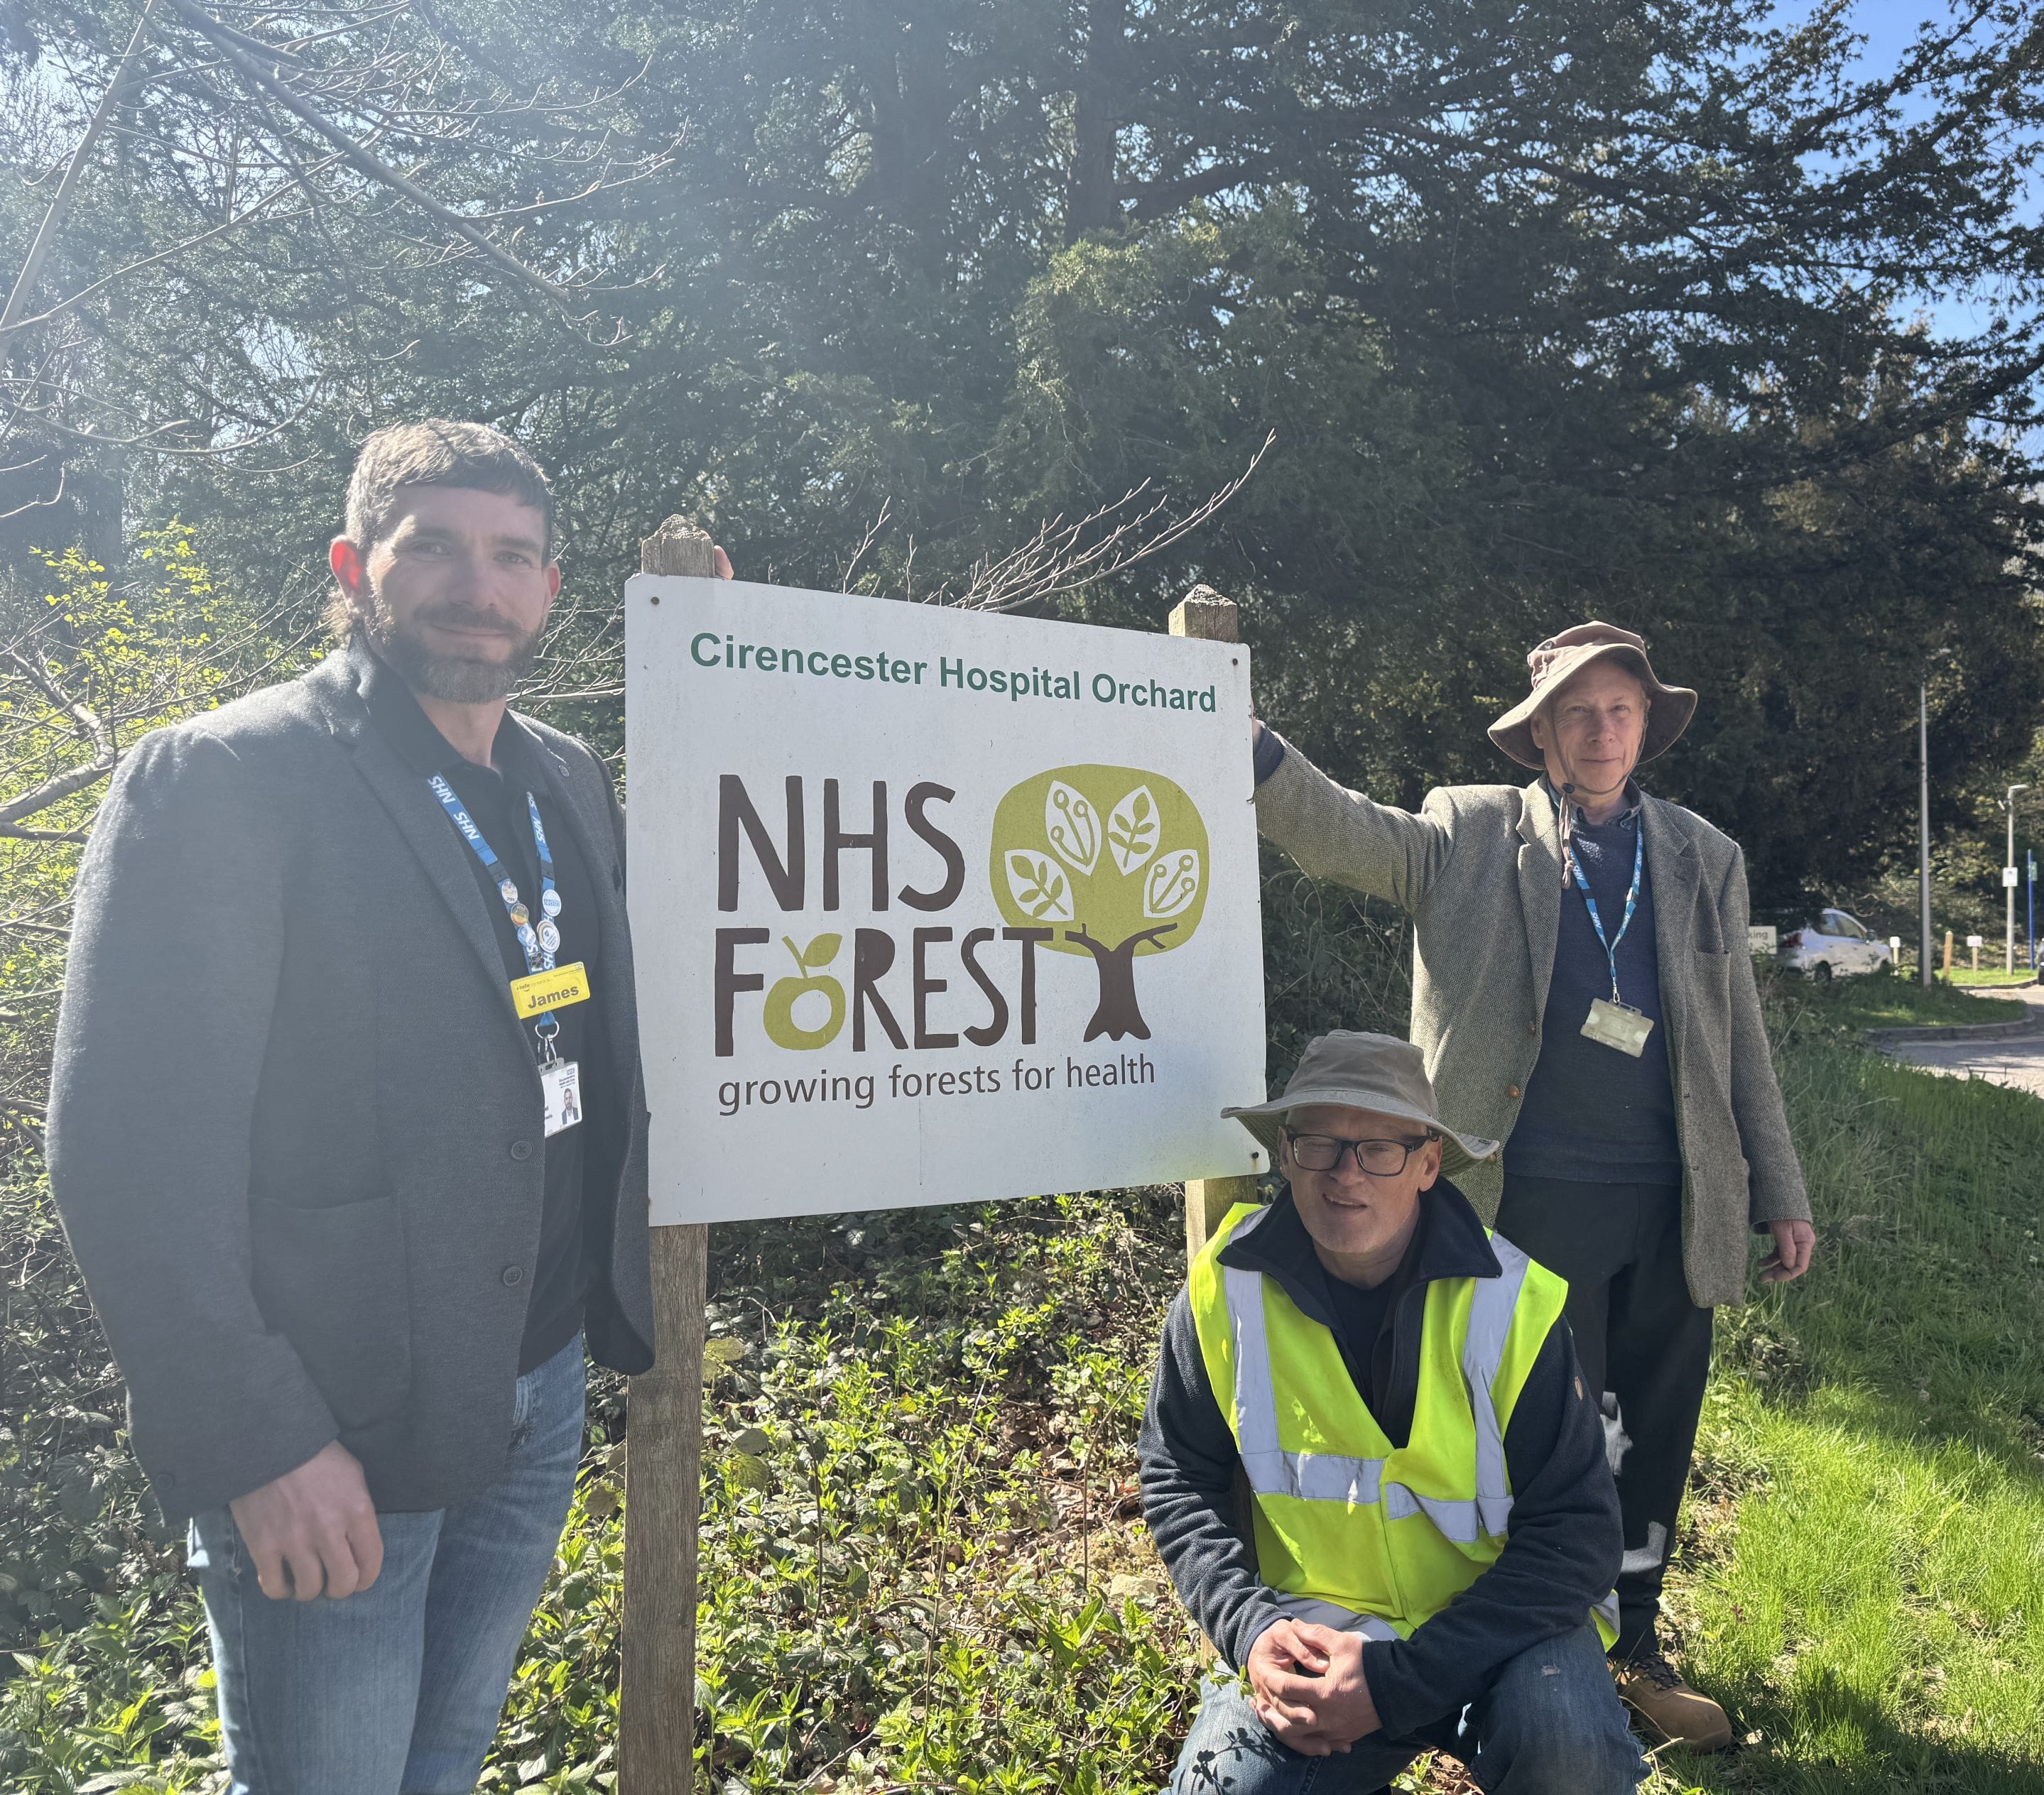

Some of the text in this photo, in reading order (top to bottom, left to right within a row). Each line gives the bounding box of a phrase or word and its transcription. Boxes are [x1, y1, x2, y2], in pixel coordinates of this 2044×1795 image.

[690, 632, 1217, 713] Cirencester Hospital Orchard
[428, 776, 455, 804] NHS
[453, 812, 479, 840] NHS
[533, 816, 545, 844] NHS
[717, 774, 967, 912] NHS
[1591, 911, 1602, 929] NHS
[543, 952, 554, 970] HS
[528, 986, 579, 1009] James
[714, 926, 1054, 1057] FOREST
[718, 1053, 1155, 1116] growing forests for health
